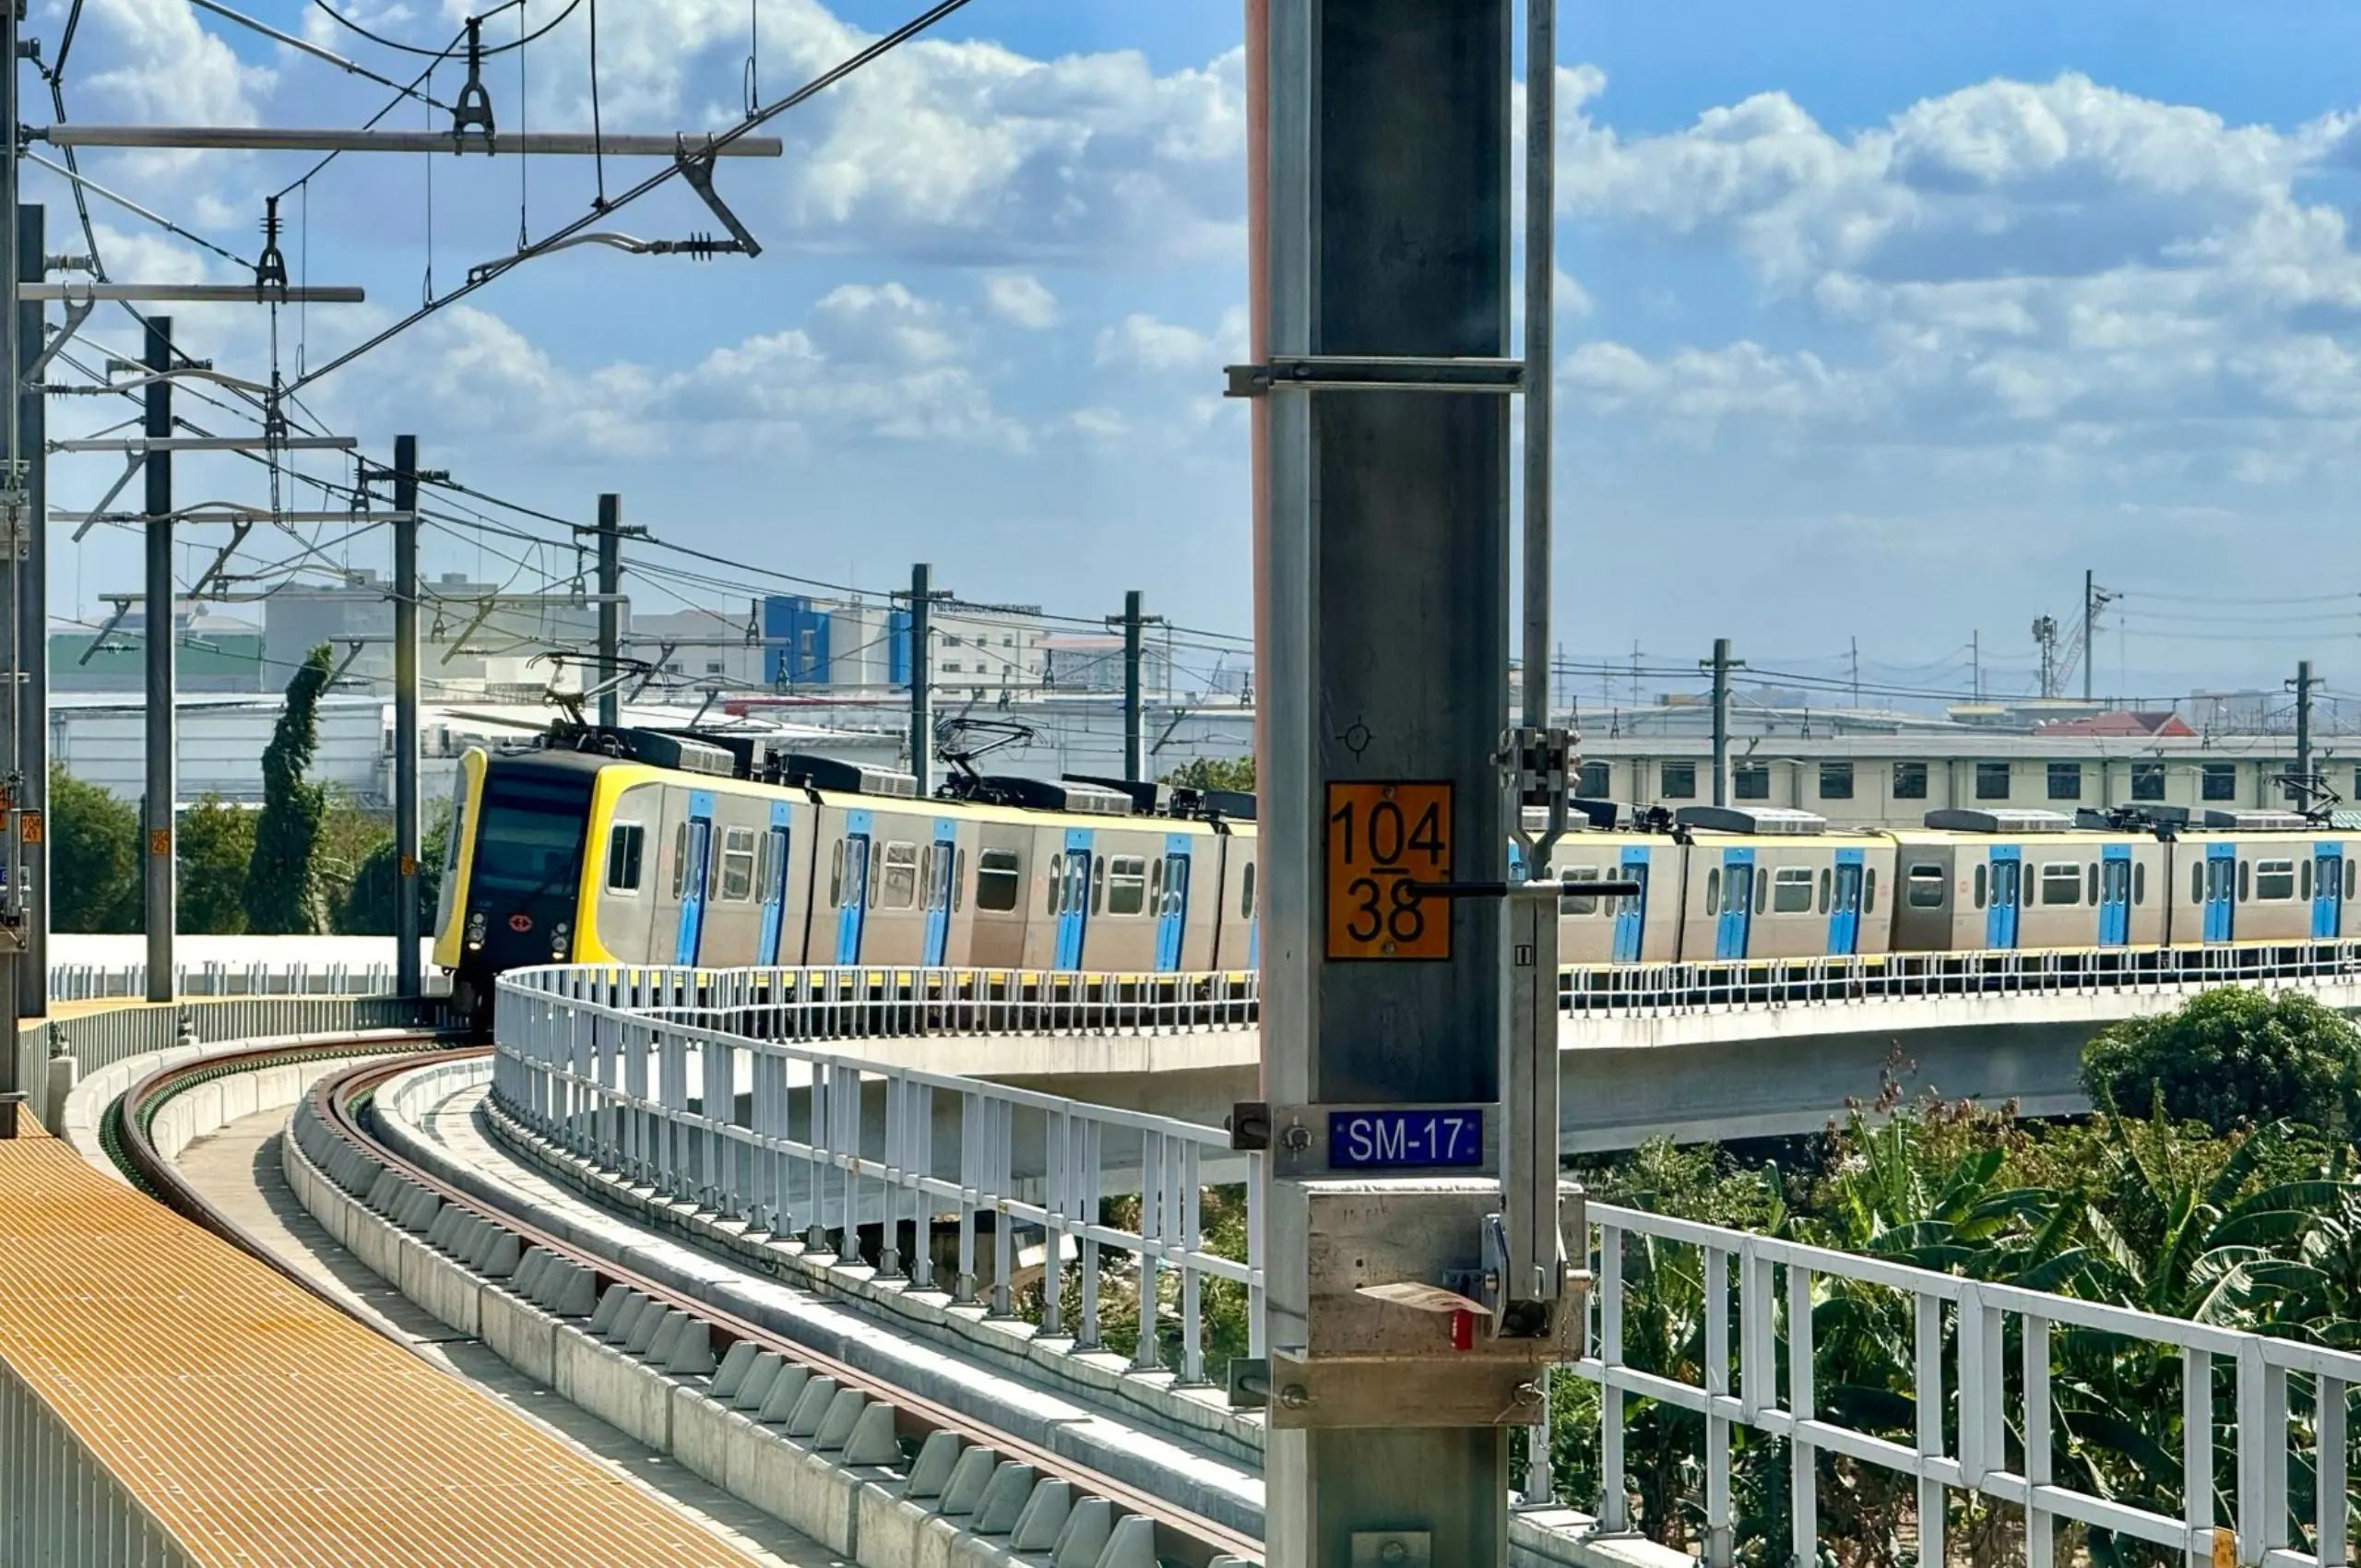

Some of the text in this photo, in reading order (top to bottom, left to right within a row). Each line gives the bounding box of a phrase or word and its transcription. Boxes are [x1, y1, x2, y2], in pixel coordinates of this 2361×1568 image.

[1332, 800, 1446, 866] 104
[1347, 877, 1425, 943] 38
[1348, 1117, 1464, 1161] SM-17
